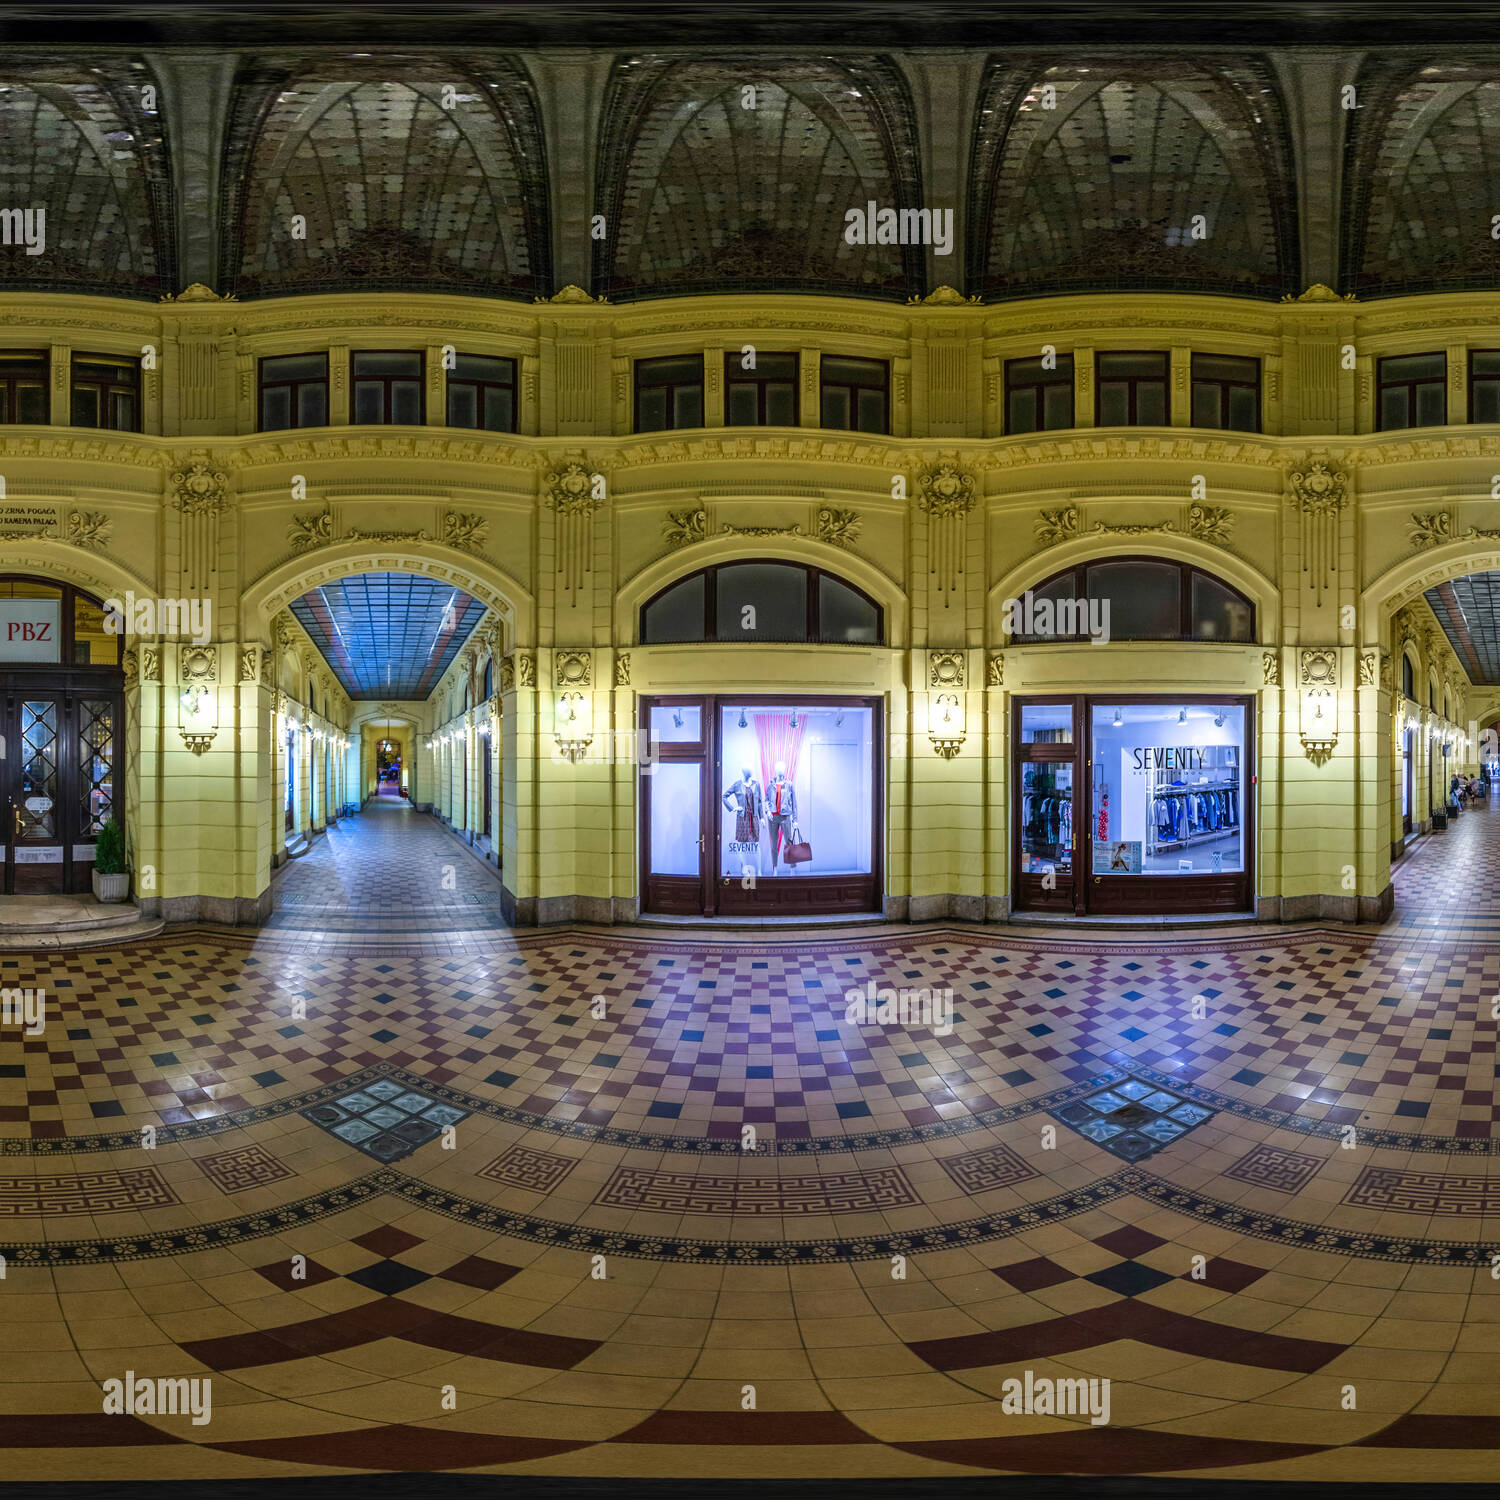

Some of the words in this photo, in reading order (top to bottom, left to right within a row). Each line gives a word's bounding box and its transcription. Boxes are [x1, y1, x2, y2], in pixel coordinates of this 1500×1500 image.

[4, 517, 32, 525] KAMENA
[7, 622, 52, 642] PBZ
[1133, 747, 1206, 770] SEVENTY
[729, 842, 759, 852] SEVENTY
